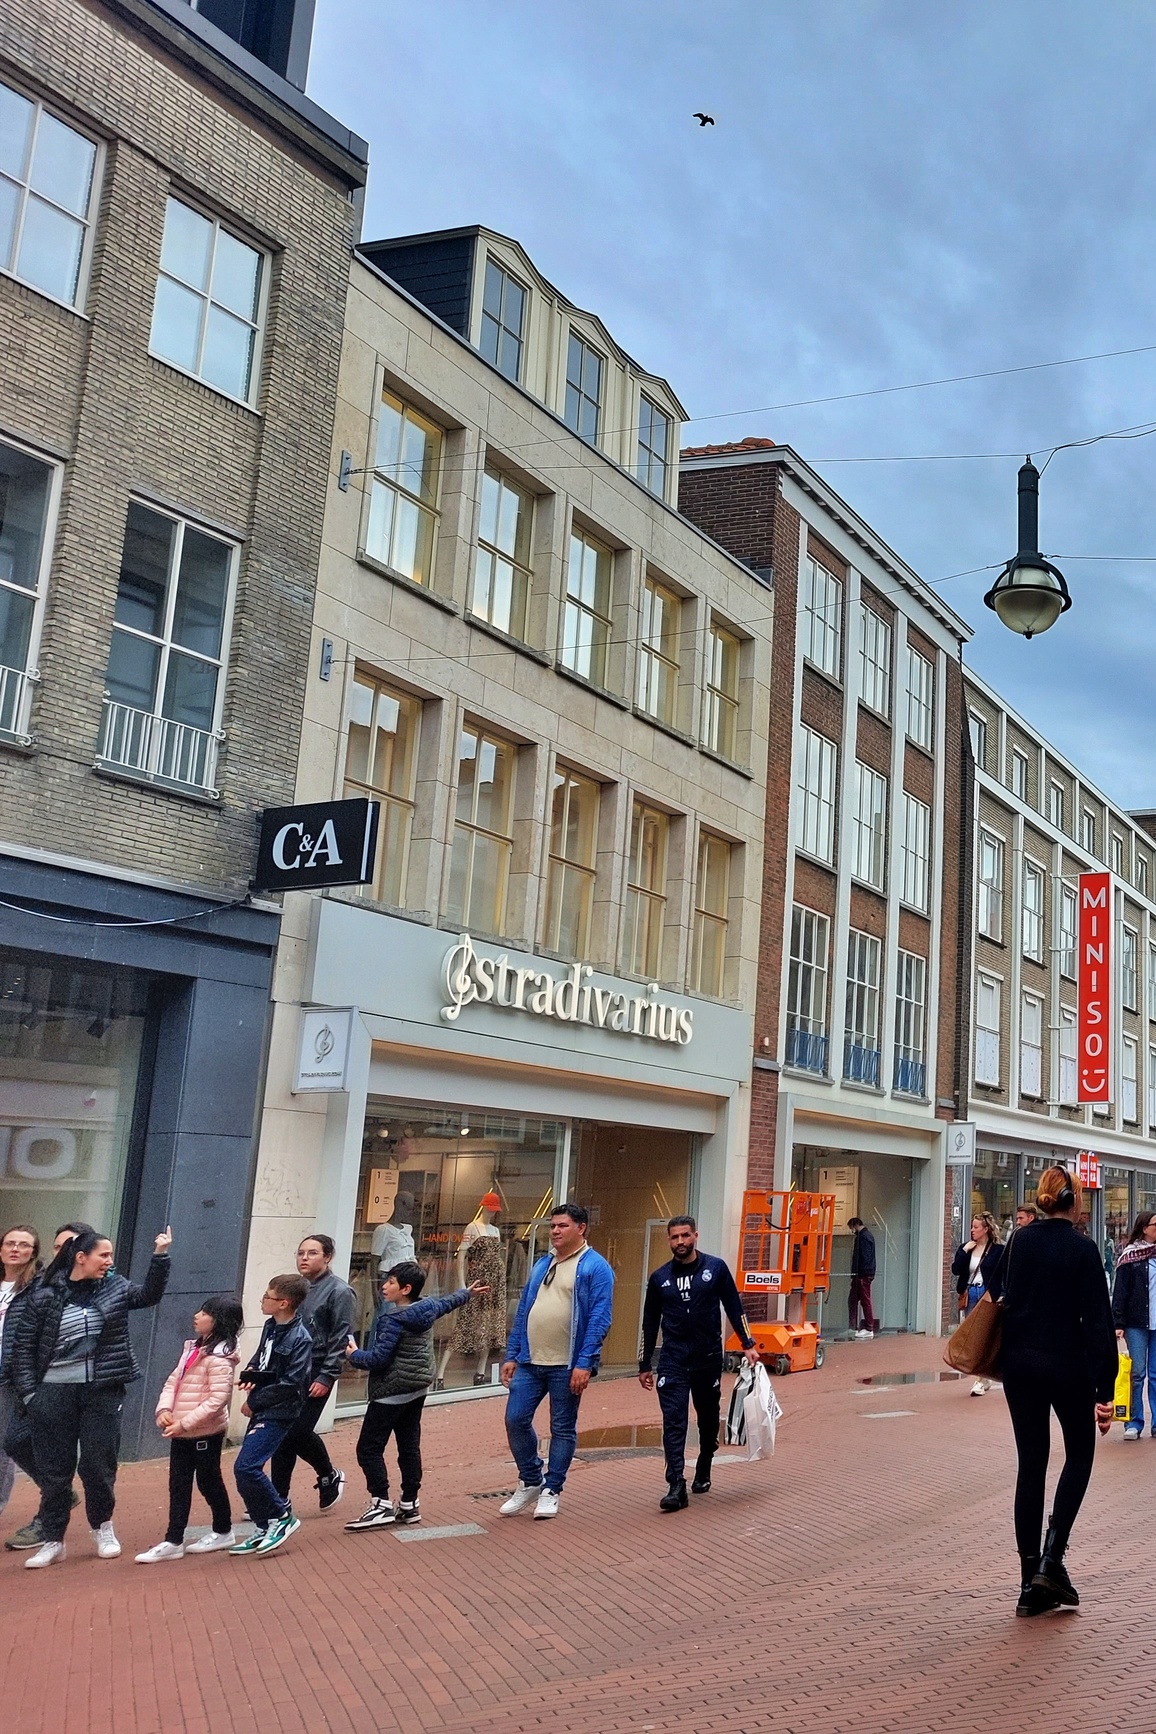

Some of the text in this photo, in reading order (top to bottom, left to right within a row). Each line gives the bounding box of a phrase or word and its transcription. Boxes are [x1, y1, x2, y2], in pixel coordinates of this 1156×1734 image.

[272, 818, 343, 870] C&A
[1083, 887, 1106, 1058] MINISO
[746, 1274, 780, 1284] Boels
